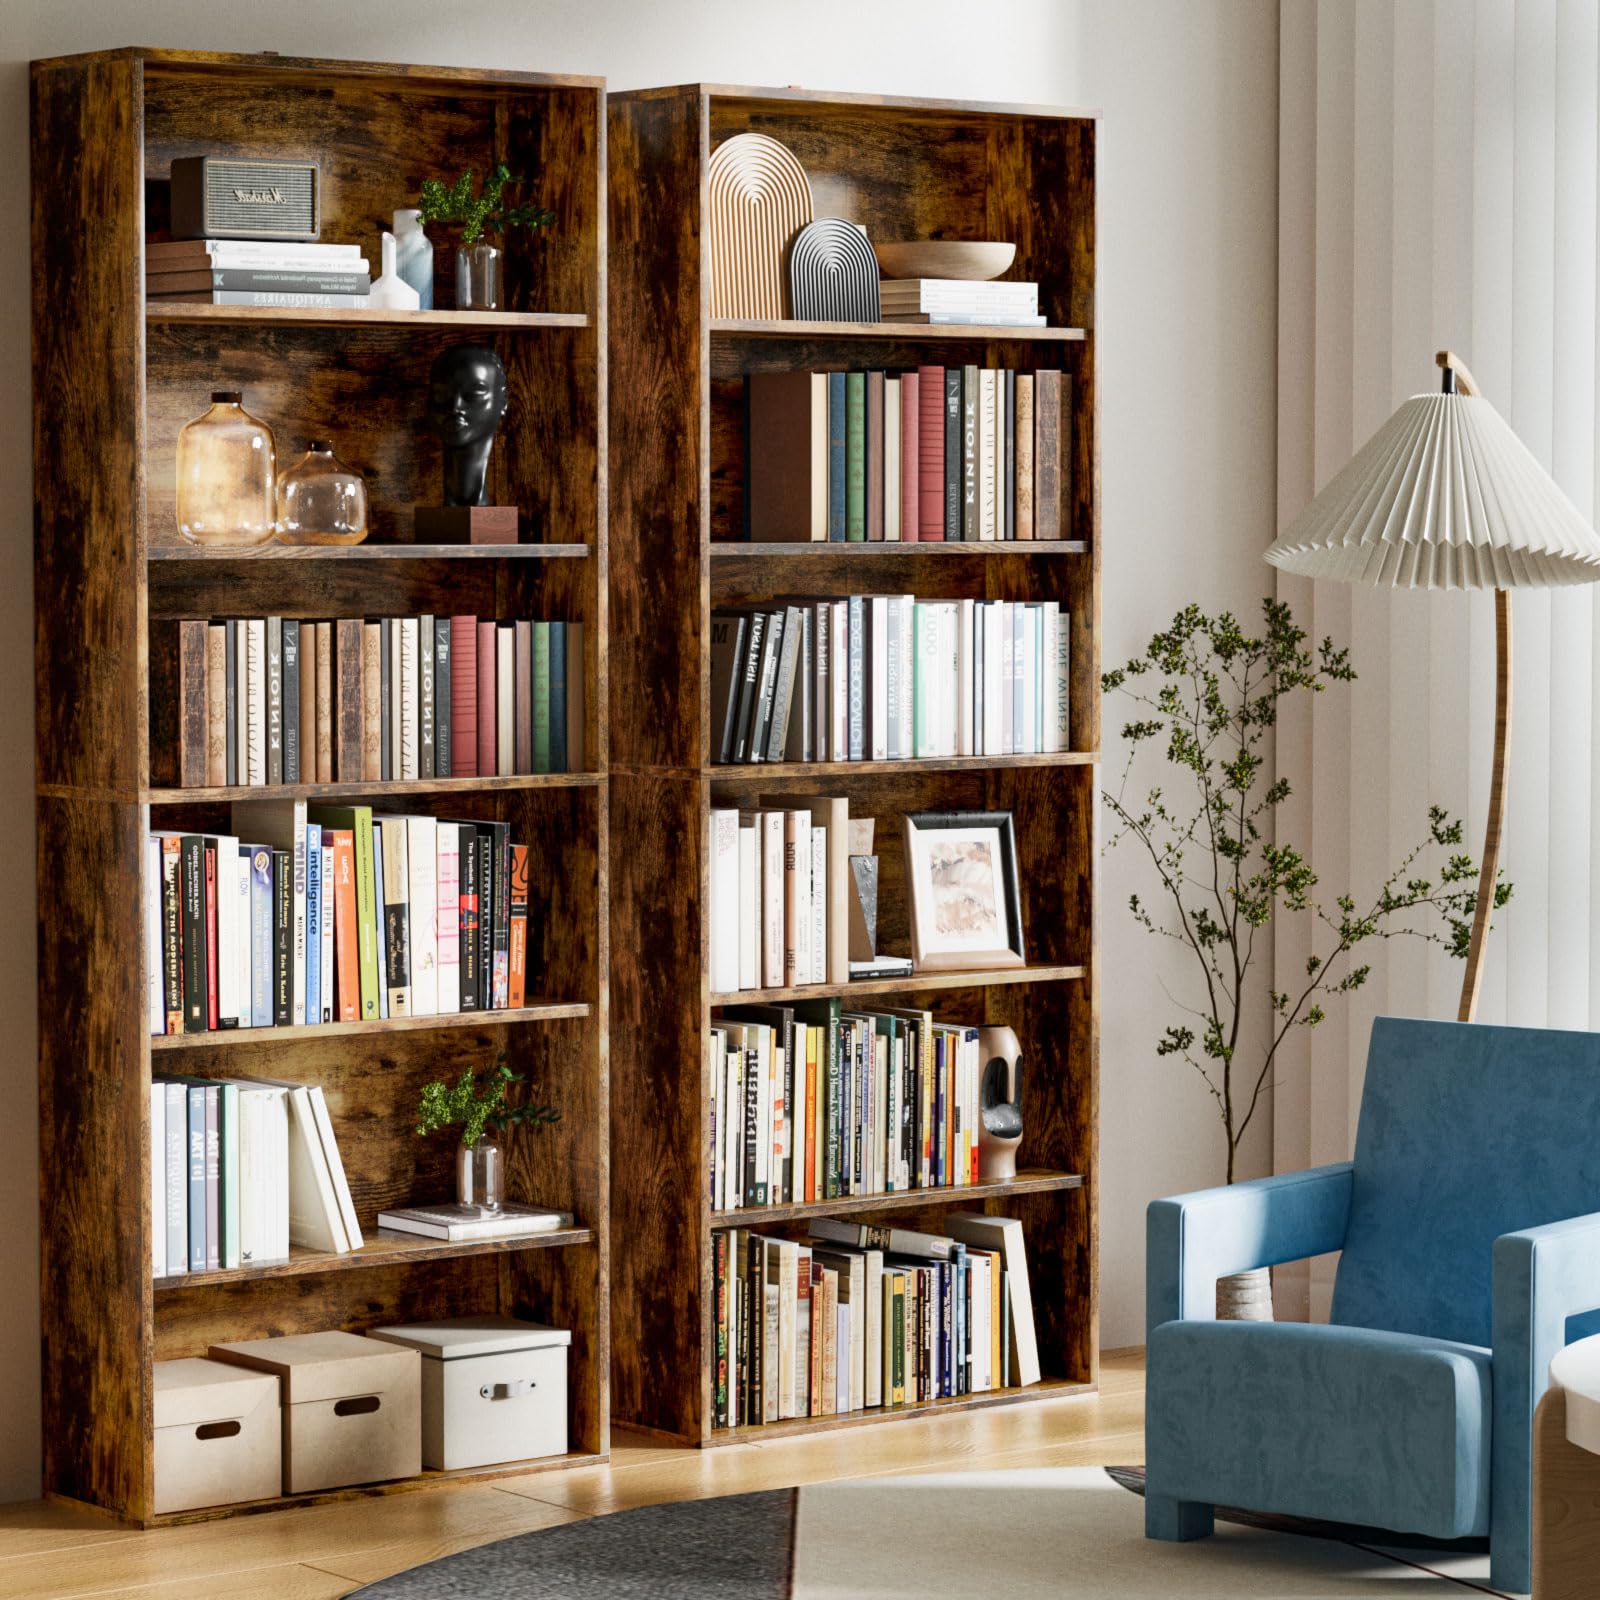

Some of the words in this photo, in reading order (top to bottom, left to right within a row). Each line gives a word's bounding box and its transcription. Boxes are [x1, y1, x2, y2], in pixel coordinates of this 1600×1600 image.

[965, 402, 975, 505] KINFOLK
[310, 830, 319, 850] on
[239, 877, 248, 896] FLOW
[295, 841, 305, 894] MIND
[307, 851, 320, 935] intelligence
[191, 1131, 204, 1160] ART
